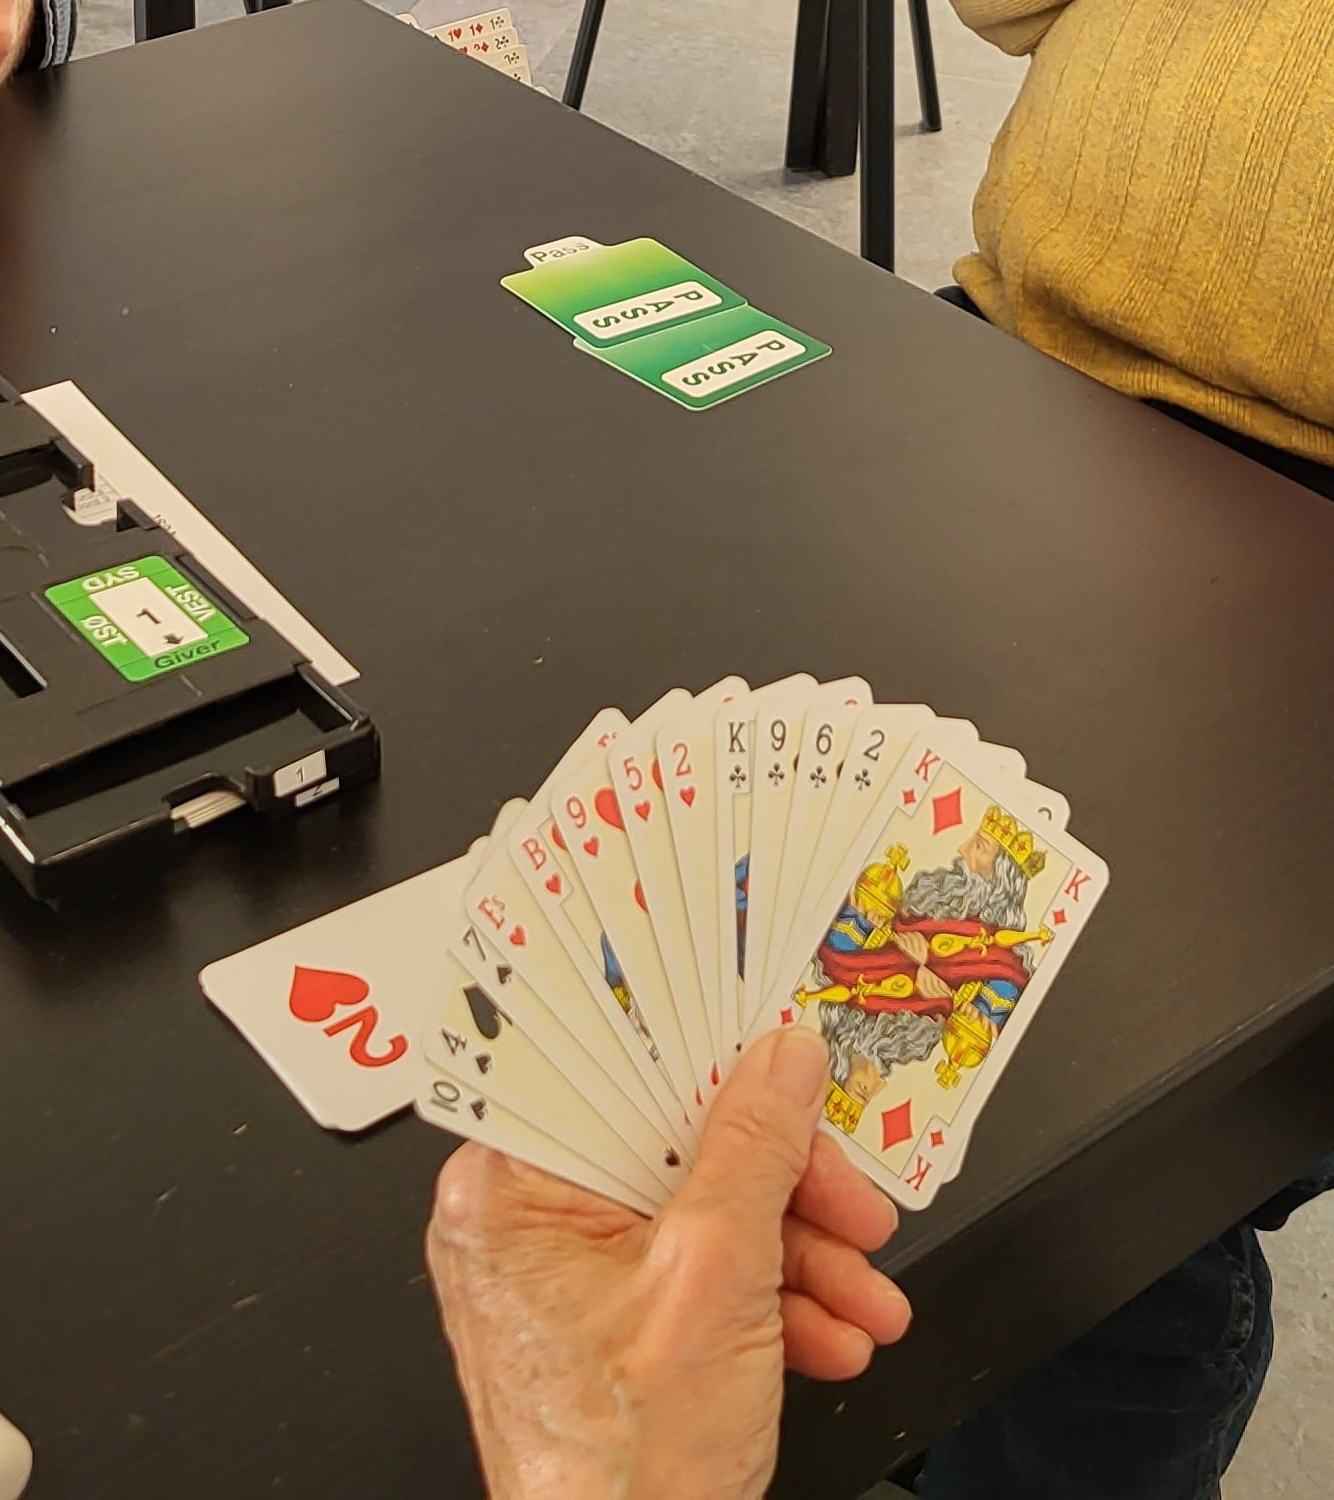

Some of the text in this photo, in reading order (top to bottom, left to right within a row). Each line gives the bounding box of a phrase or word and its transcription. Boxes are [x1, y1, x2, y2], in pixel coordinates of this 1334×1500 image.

[530, 241, 590, 263] Pass
[592, 289, 704, 329] PASS
[682, 338, 786, 387] PASS
[82, 566, 140, 592] SYD
[136, 607, 162, 625] 1
[165, 584, 216, 623] VEST
[80, 615, 129, 647] ØST
[154, 639, 220, 669] Giver
[728, 721, 747, 753] K
[769, 719, 787, 751] 9
[815, 723, 834, 756] 6
[863, 729, 886, 762] 2
[294, 766, 304, 783] 1
[623, 756, 644, 791] 5
[672, 742, 692, 777] 2
[914, 747, 942, 782] K
[566, 795, 588, 829] 9
[521, 837, 547, 871] B
[1064, 867, 1092, 902] K
[462, 926, 487, 962] 7
[322, 1003, 410, 1068] 2
[441, 1027, 468, 1056] 4
[431, 1080, 461, 1113] 10
[905, 1154, 933, 1192] K
